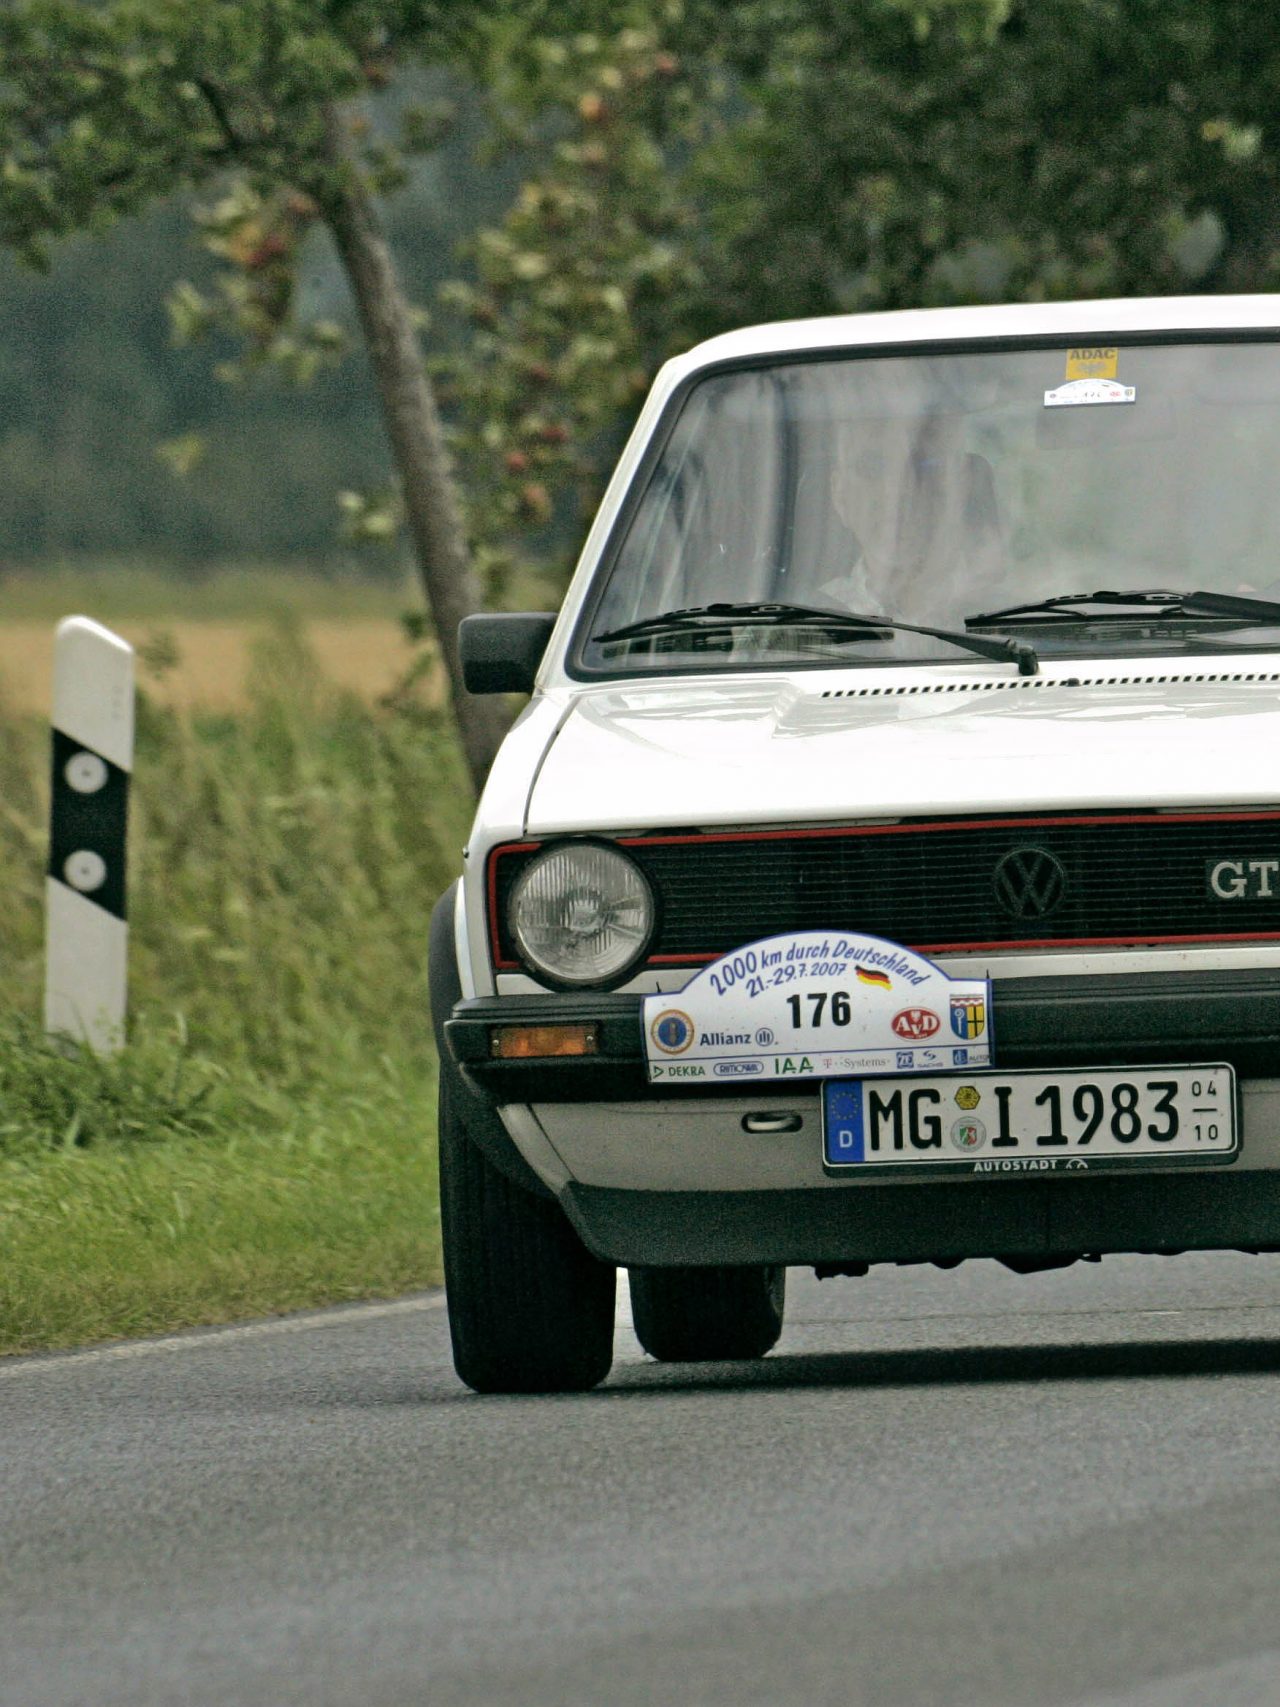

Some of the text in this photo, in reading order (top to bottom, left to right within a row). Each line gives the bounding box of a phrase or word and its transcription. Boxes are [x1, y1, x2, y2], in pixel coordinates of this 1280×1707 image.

[1070, 349, 1117, 360] ADAC
[710, 940, 931, 996] 2000 km durch Deutschland
[786, 991, 852, 1029] 176
[699, 1032, 752, 1046] Allianz
[668, 1066, 706, 1077] DEKRA
[774, 1057, 814, 1074] IAA
[1191, 1080, 1218, 1098] 04
[869, 1088, 943, 1151] MG
[1036, 1081, 1180, 1147] 1983
[838, 1130, 853, 1148] D
[1194, 1124, 1220, 1142] 10
[973, 1159, 1058, 1173] AUTOSTADT
